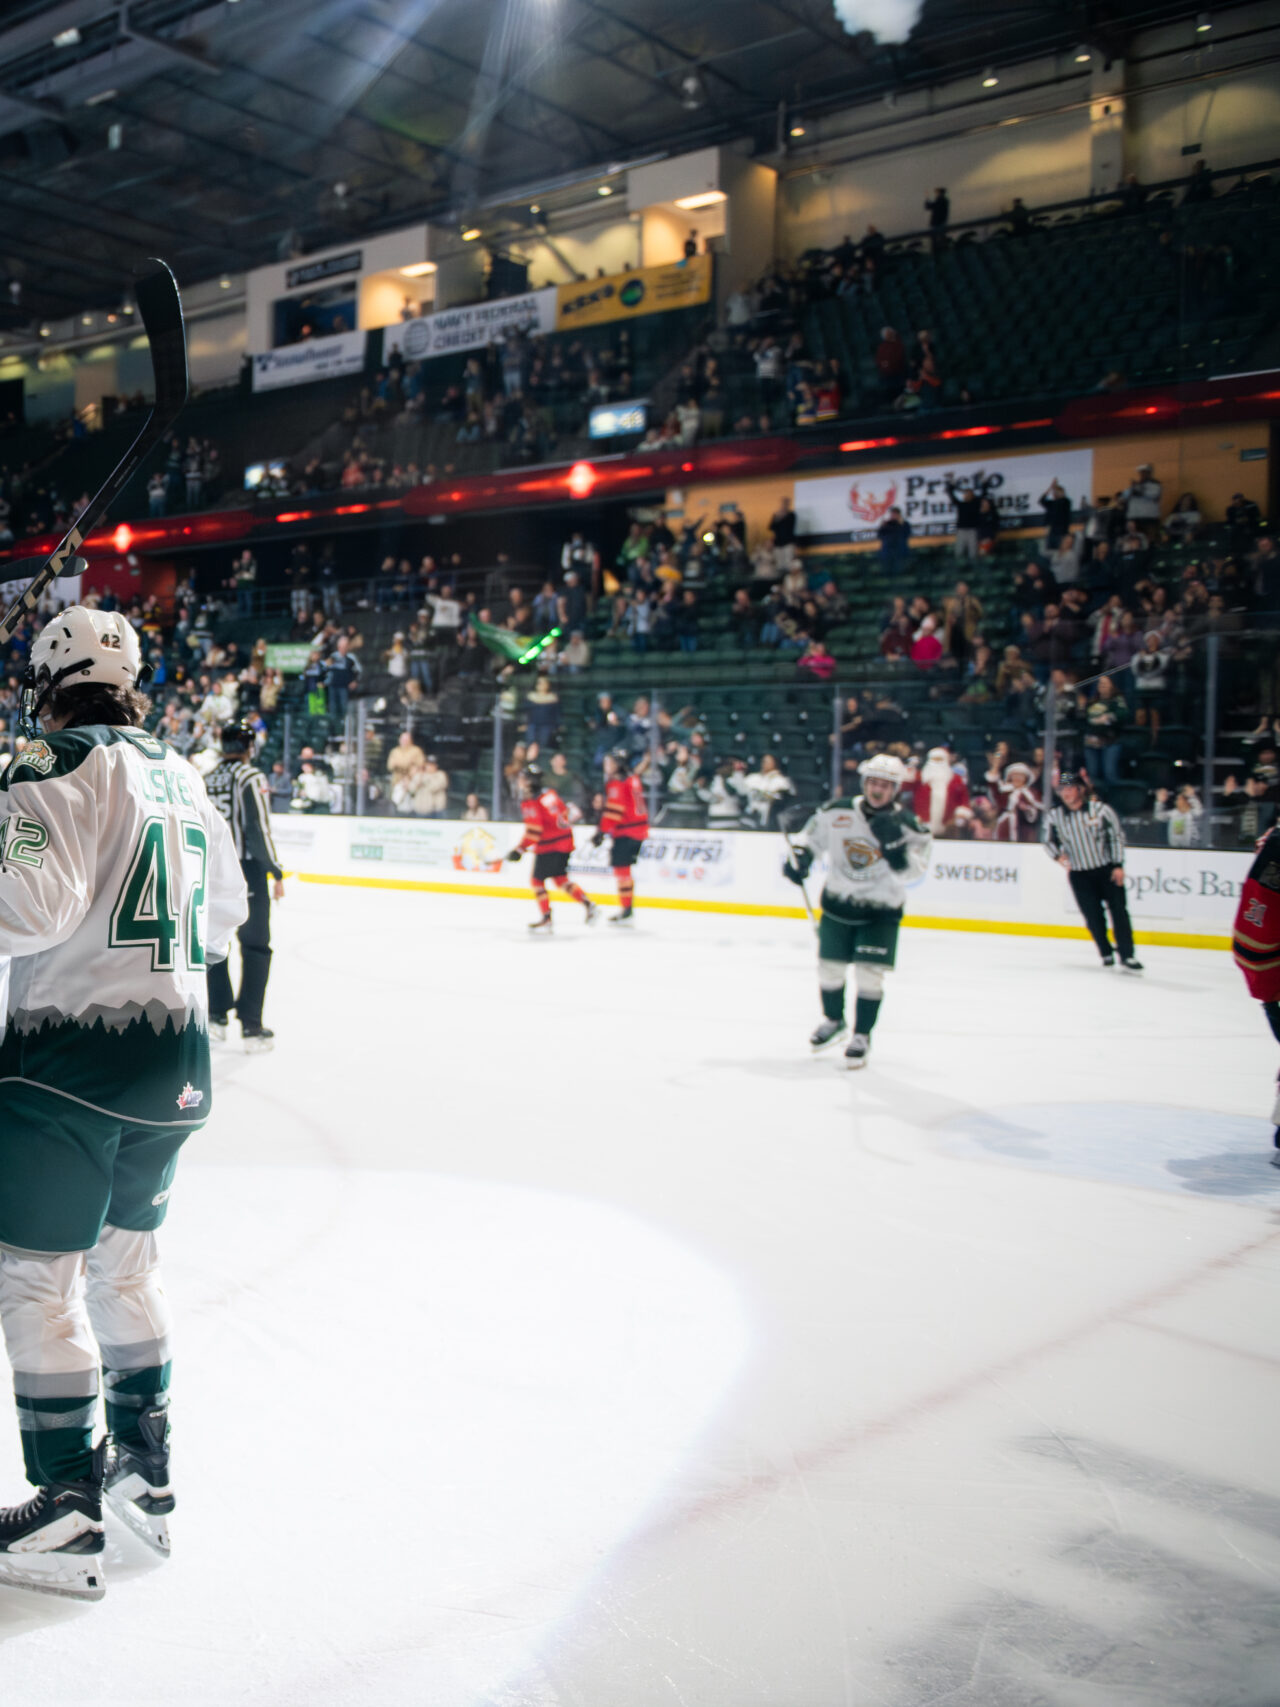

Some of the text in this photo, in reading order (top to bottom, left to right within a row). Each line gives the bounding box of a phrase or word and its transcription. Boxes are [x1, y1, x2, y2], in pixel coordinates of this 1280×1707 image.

[100, 633, 121, 649] 42
[640, 845, 667, 859] GO
[935, 863, 1019, 883] SWEDISH
[1200, 870, 1244, 898] Ba
[107, 816, 208, 973] 42
